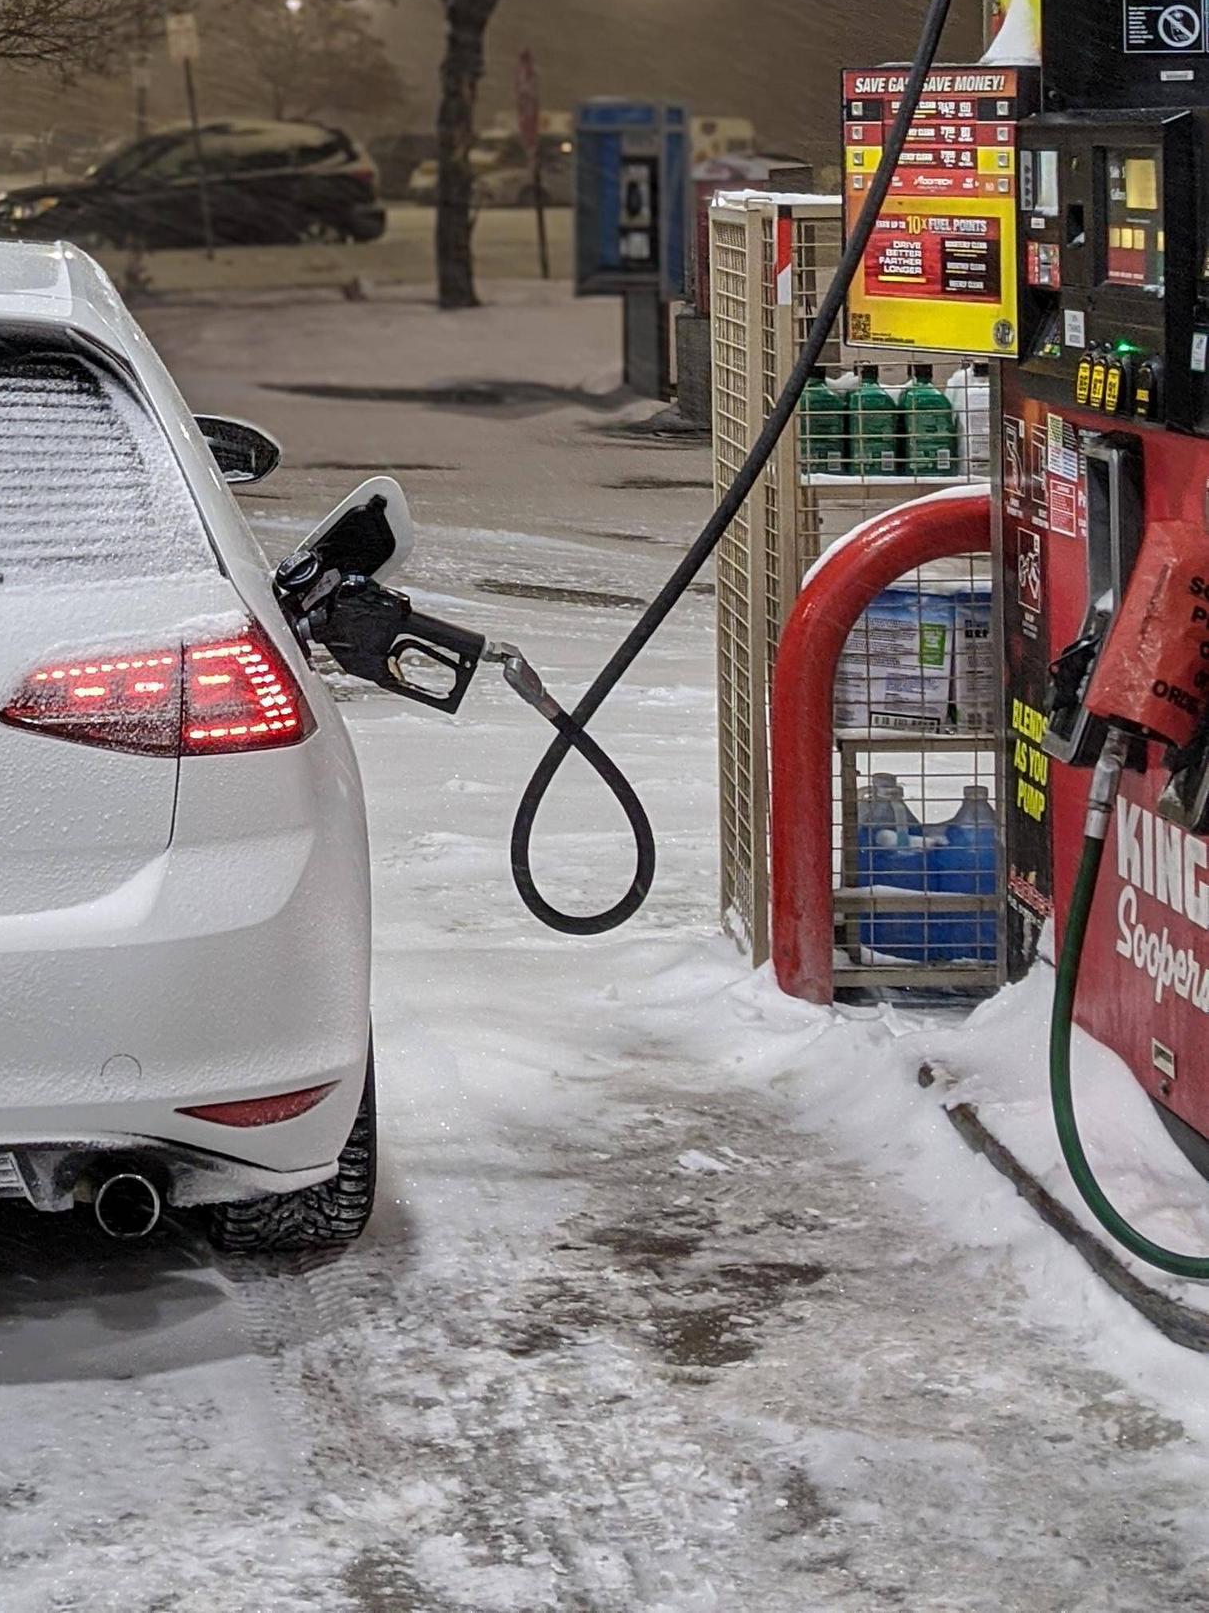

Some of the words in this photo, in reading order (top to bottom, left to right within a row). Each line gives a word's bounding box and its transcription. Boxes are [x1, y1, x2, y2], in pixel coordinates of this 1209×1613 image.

[855, 77, 886, 93] SAVE
[888, 77, 910, 93] GA
[954, 75, 1006, 92] MONEY!
[929, 218, 951, 232] FUEL
[953, 218, 988, 233] POINTS
[886, 248, 922, 258] BETTER
[893, 240, 922, 250] DRIVE
[884, 265, 922, 275] LONGER
[1013, 738, 1028, 774] AS
[1028, 742, 1048, 787] YOU
[1017, 776, 1046, 823] PUMP
[1116, 793, 1209, 930] KING
